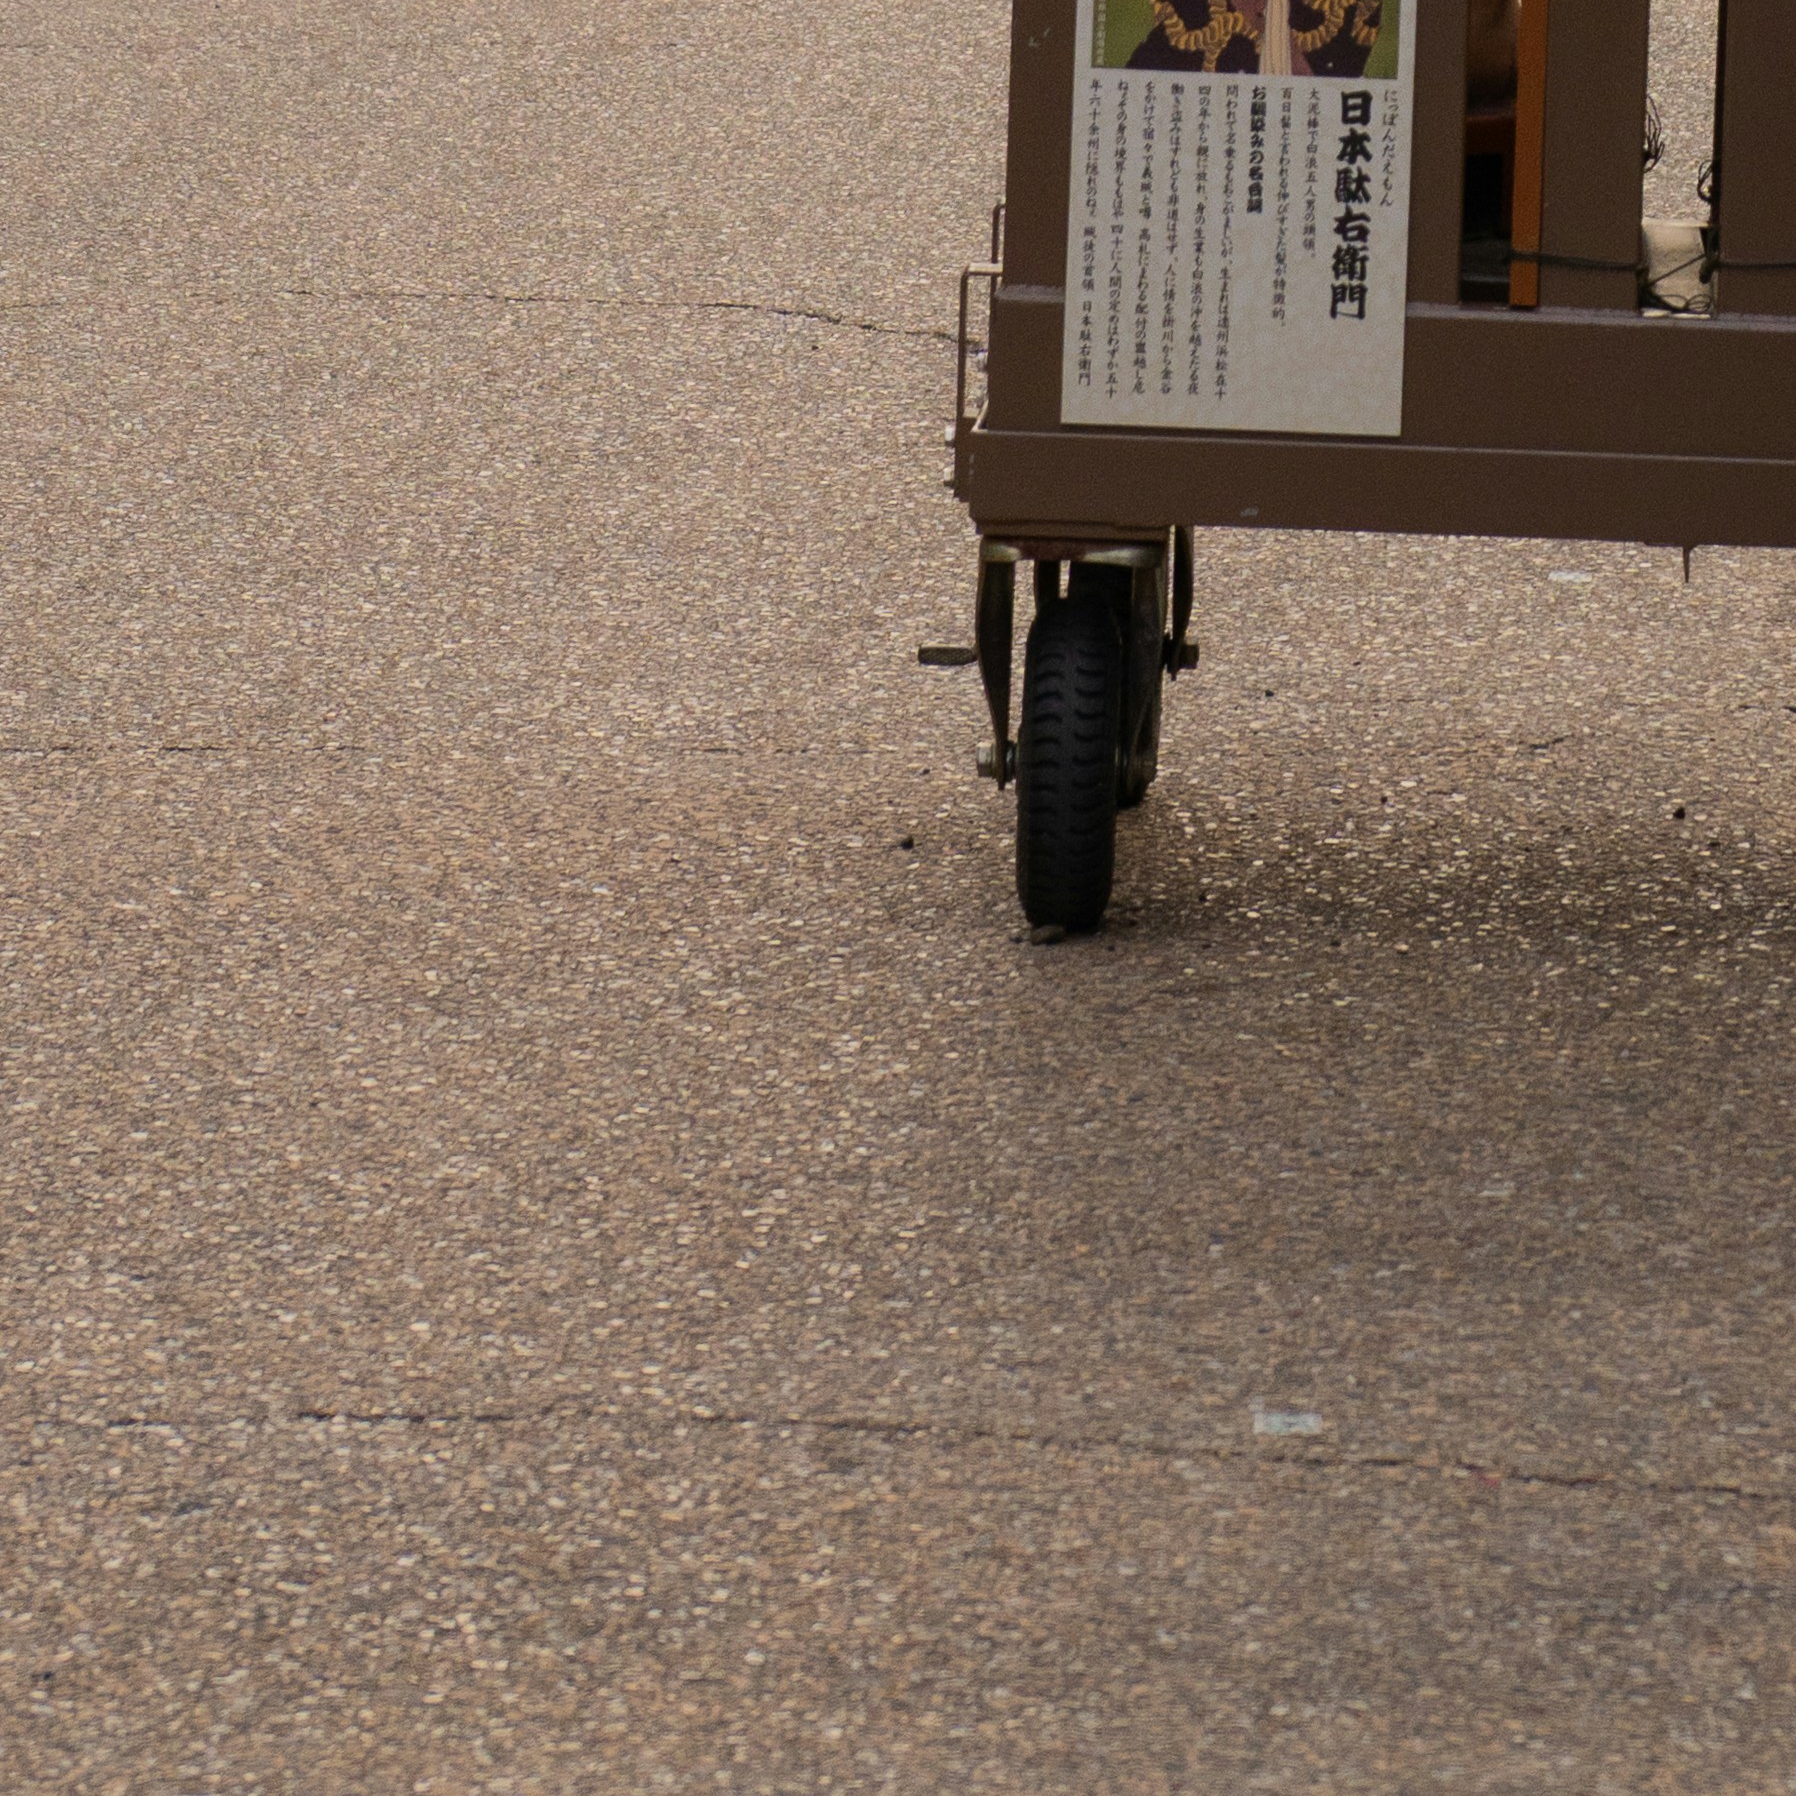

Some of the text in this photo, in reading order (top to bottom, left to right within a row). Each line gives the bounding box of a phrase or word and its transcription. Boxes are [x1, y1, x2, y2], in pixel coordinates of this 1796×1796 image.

[1328, 89, 1373, 321] 日本駄右衛門
[1379, 90, 1399, 207] にっぽんだえもん
